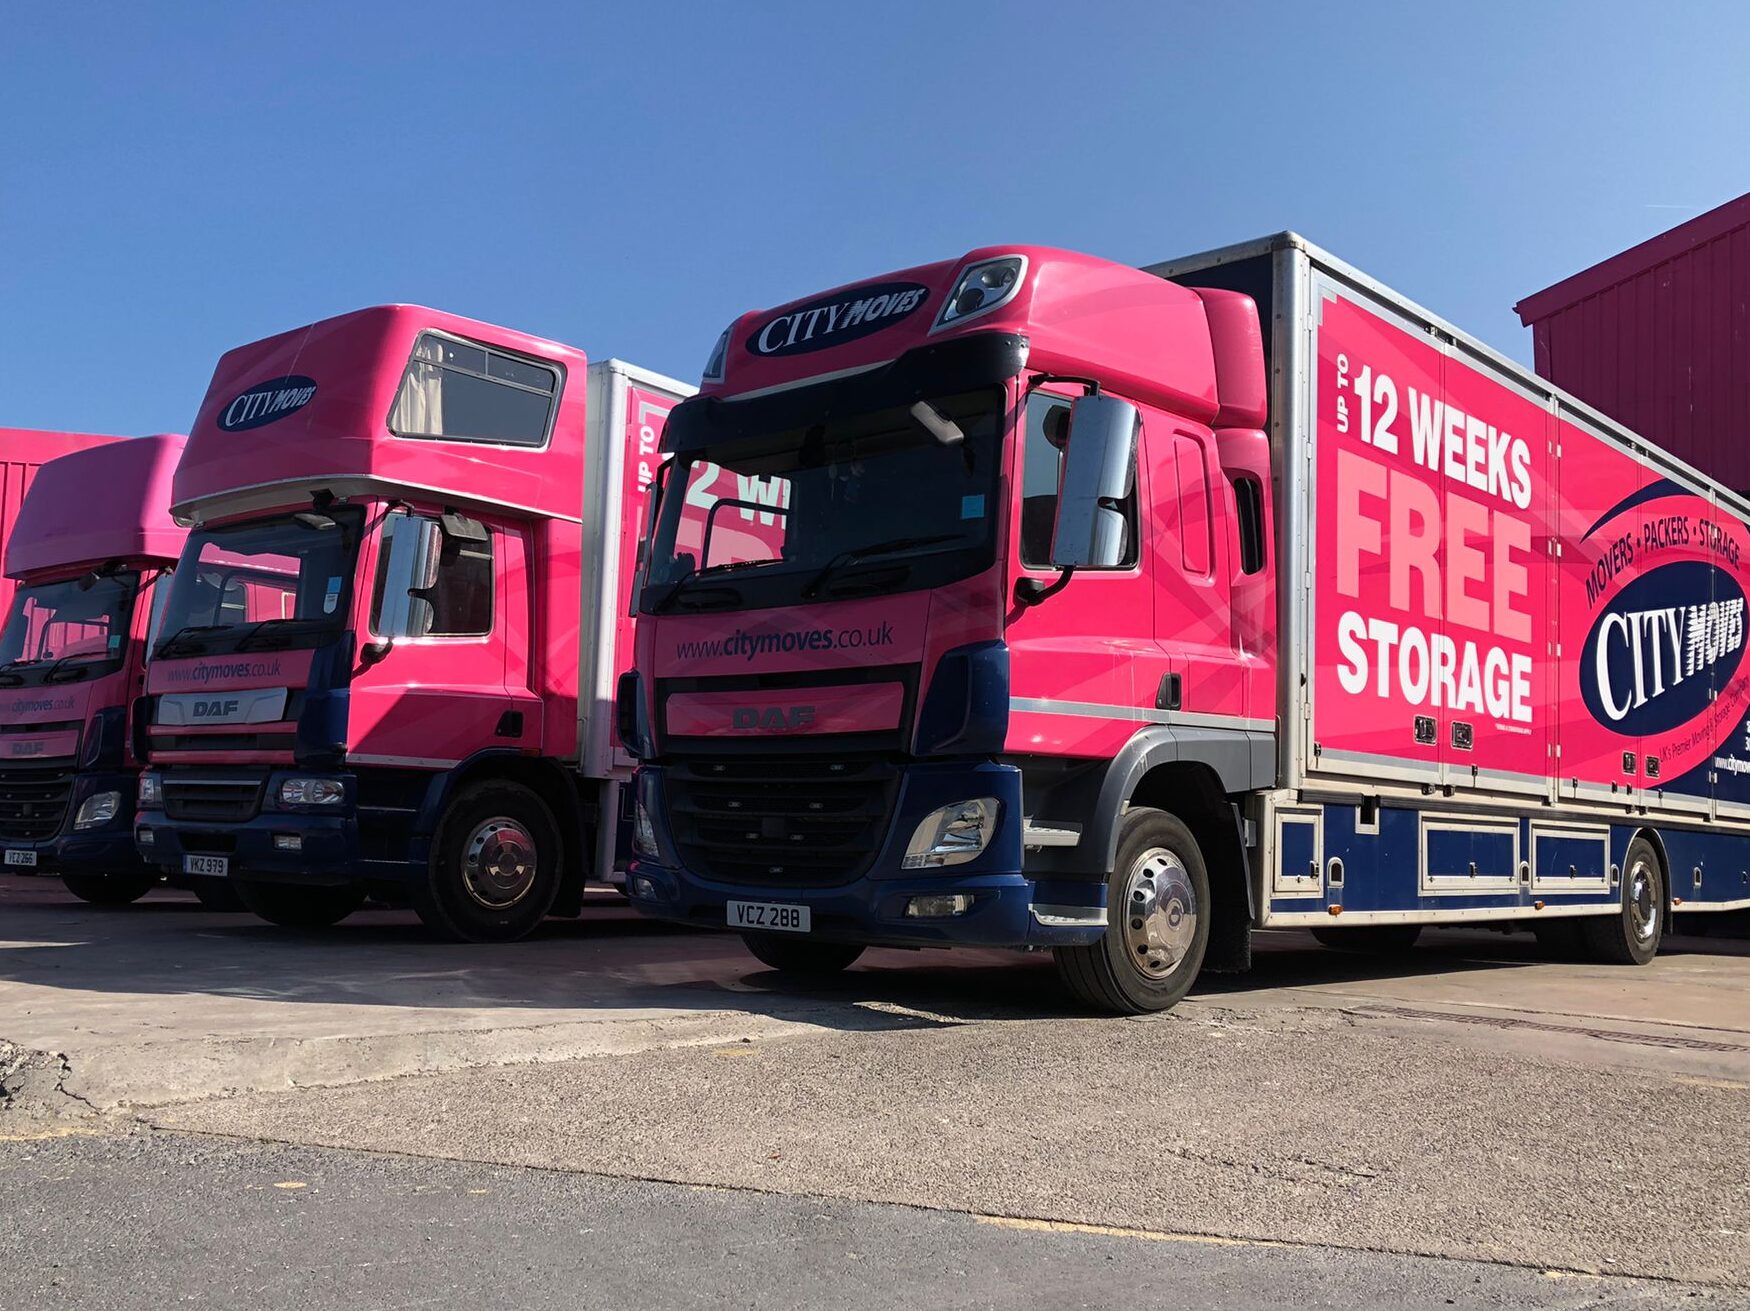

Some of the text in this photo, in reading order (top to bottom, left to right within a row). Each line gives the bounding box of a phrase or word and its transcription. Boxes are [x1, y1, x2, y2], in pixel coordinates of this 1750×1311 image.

[1337, 353, 1349, 433] UP TO
[639, 425, 655, 456] TO
[1354, 364, 1532, 510] 12 WEEKS
[1336, 447, 1533, 644] FREE
[1585, 516, 1741, 610] MOVERS PACKERS STORAGE
[676, 621, 894, 661] www.citymoves.co.uk
[168, 658, 281, 685] www.citymoves.co.uk
[1336, 610, 1533, 723] STORAGE
[193, 700, 239, 717] DAF
[732, 705, 816, 729] DAF
[735, 903, 801, 928] VCZ 288
